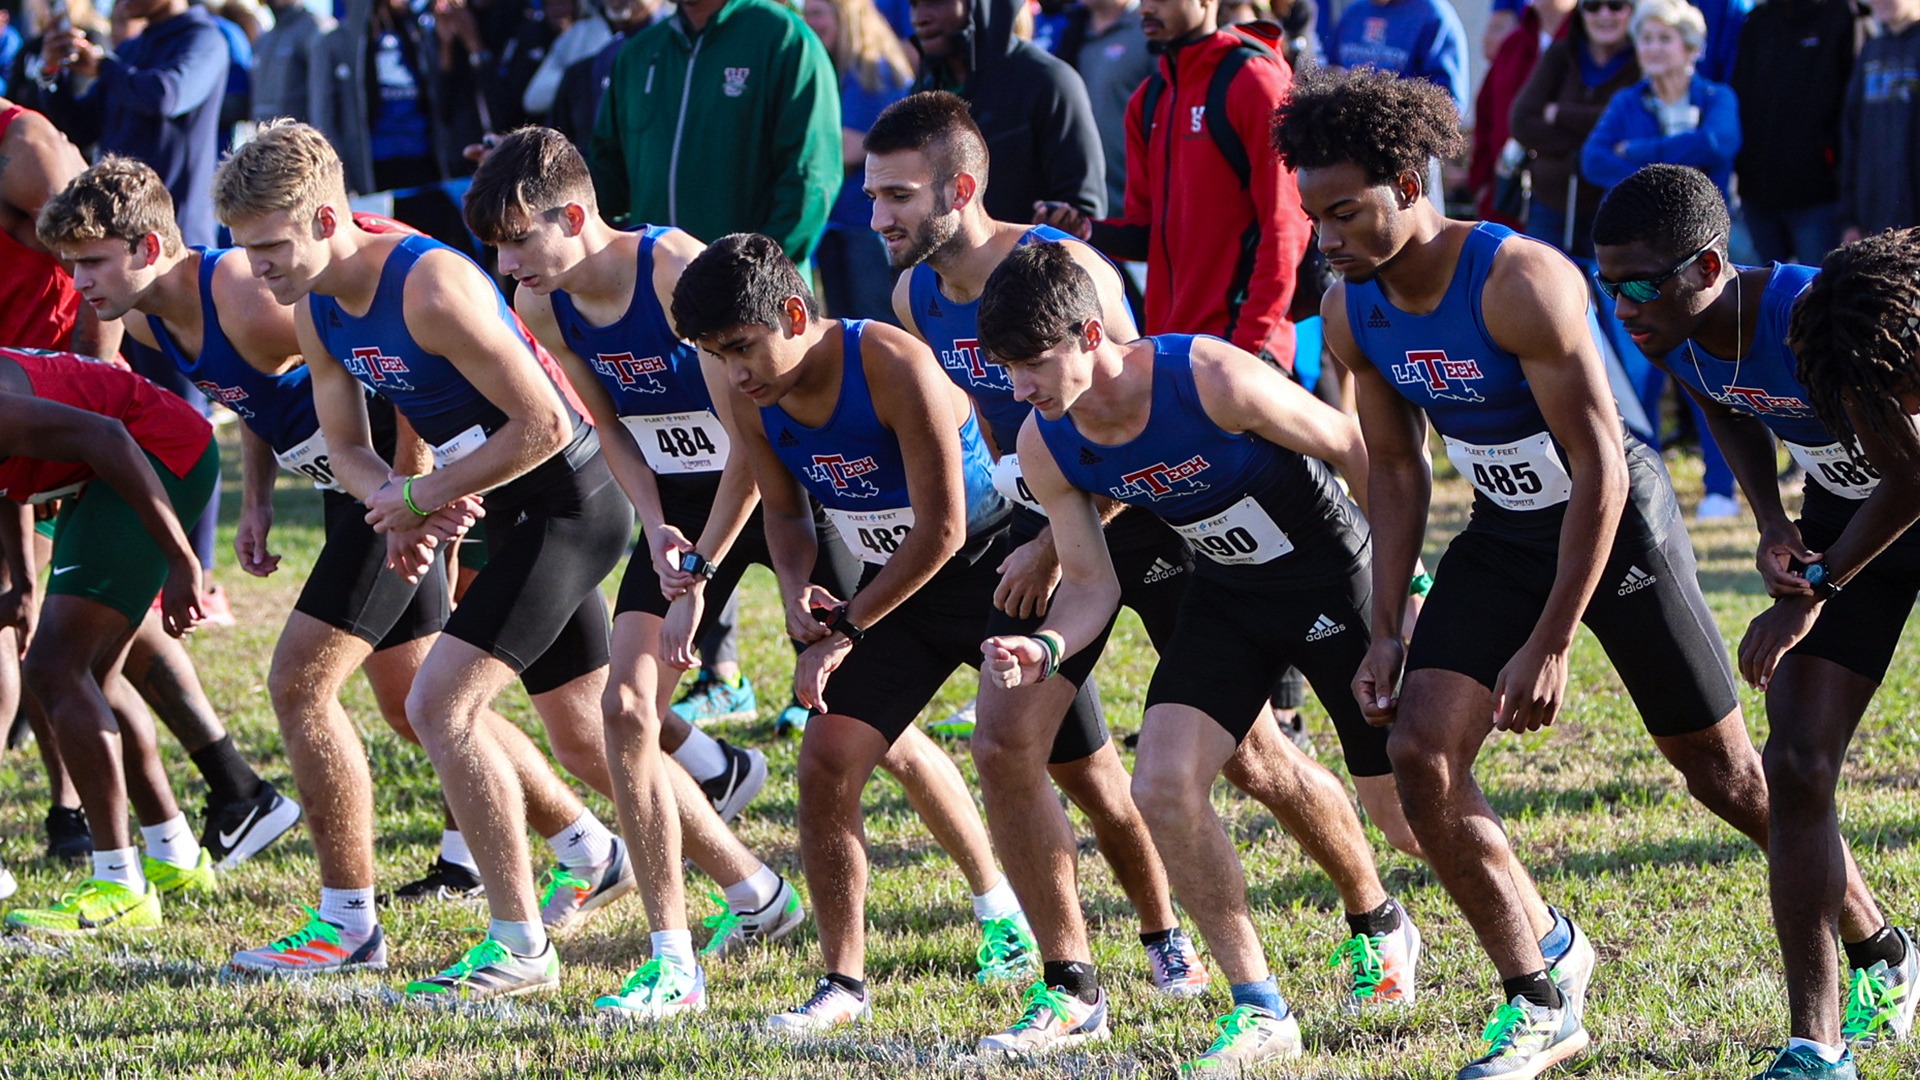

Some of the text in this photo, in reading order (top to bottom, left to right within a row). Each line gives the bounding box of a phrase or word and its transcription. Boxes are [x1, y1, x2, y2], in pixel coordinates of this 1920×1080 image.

[656, 426, 716, 458] 484
[1464, 447, 1519, 456] FLEET FEET
[1472, 461, 1543, 497] 485
[877, 512, 897, 521] FEET
[1208, 515, 1229, 528] FEET
[1143, 565, 1184, 584] adidas
[1618, 574, 1657, 596] adidas
[1305, 623, 1346, 642] adidas
